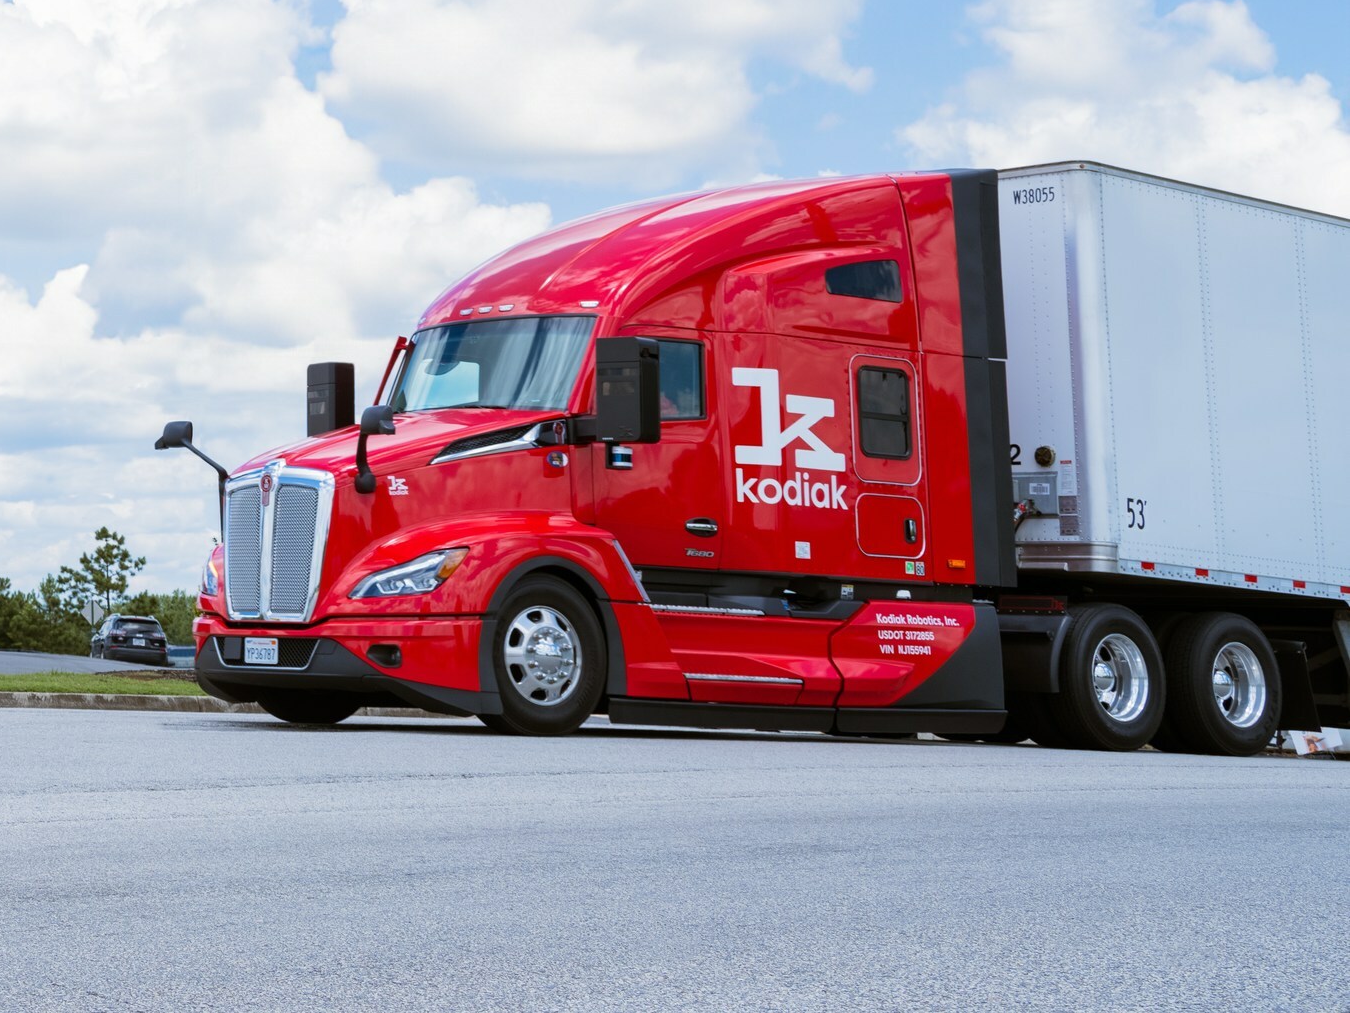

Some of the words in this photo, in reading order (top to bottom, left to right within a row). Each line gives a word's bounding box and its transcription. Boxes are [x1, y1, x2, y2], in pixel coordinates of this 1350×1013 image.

[1012, 186, 1055, 205] W38055
[735, 467, 849, 511] kodiak
[684, 547, 715, 558] T680
[875, 613, 907, 625] Kodiak
[906, 614, 945, 627] Robotics,
[944, 615, 961, 626] Inc.
[877, 630, 904, 640] USDOT
[879, 644, 895, 654] VIN
